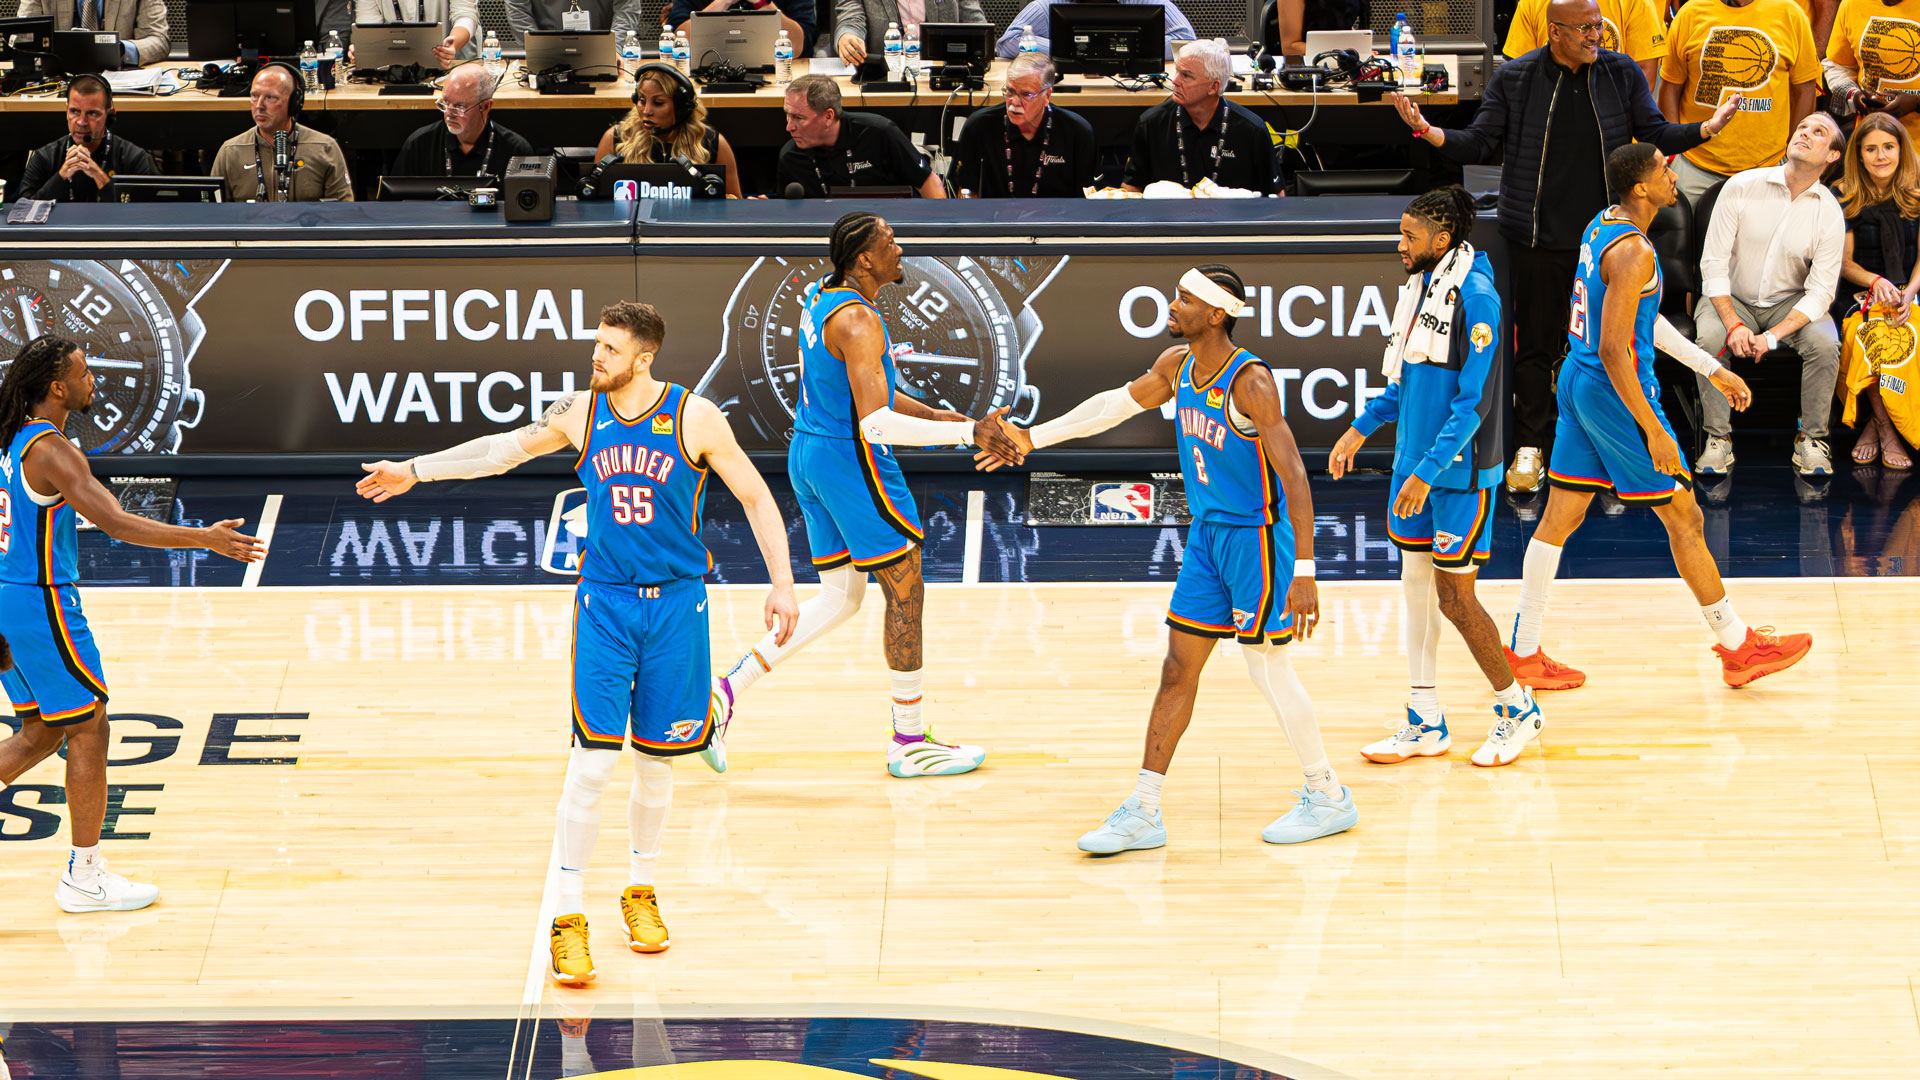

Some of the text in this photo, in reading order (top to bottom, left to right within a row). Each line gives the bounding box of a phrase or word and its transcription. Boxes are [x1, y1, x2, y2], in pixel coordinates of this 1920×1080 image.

[1748, 98, 1772, 111] FINALS
[61, 304, 95, 335] TISSOT
[69, 284, 112, 325] 12
[294, 288, 599, 342] OFFICIAL
[898, 301, 930, 331] TISSOT
[906, 280, 949, 322] 12
[323, 371, 575, 423] WATCH
[1886, 374, 1907, 395] FINALS
[1178, 406, 1228, 451] HUNDER
[591, 443, 676, 486] THUNDER
[1192, 445, 1209, 486] 2
[610, 484, 654, 526] 55
[1100, 512, 1129, 520] NBA
